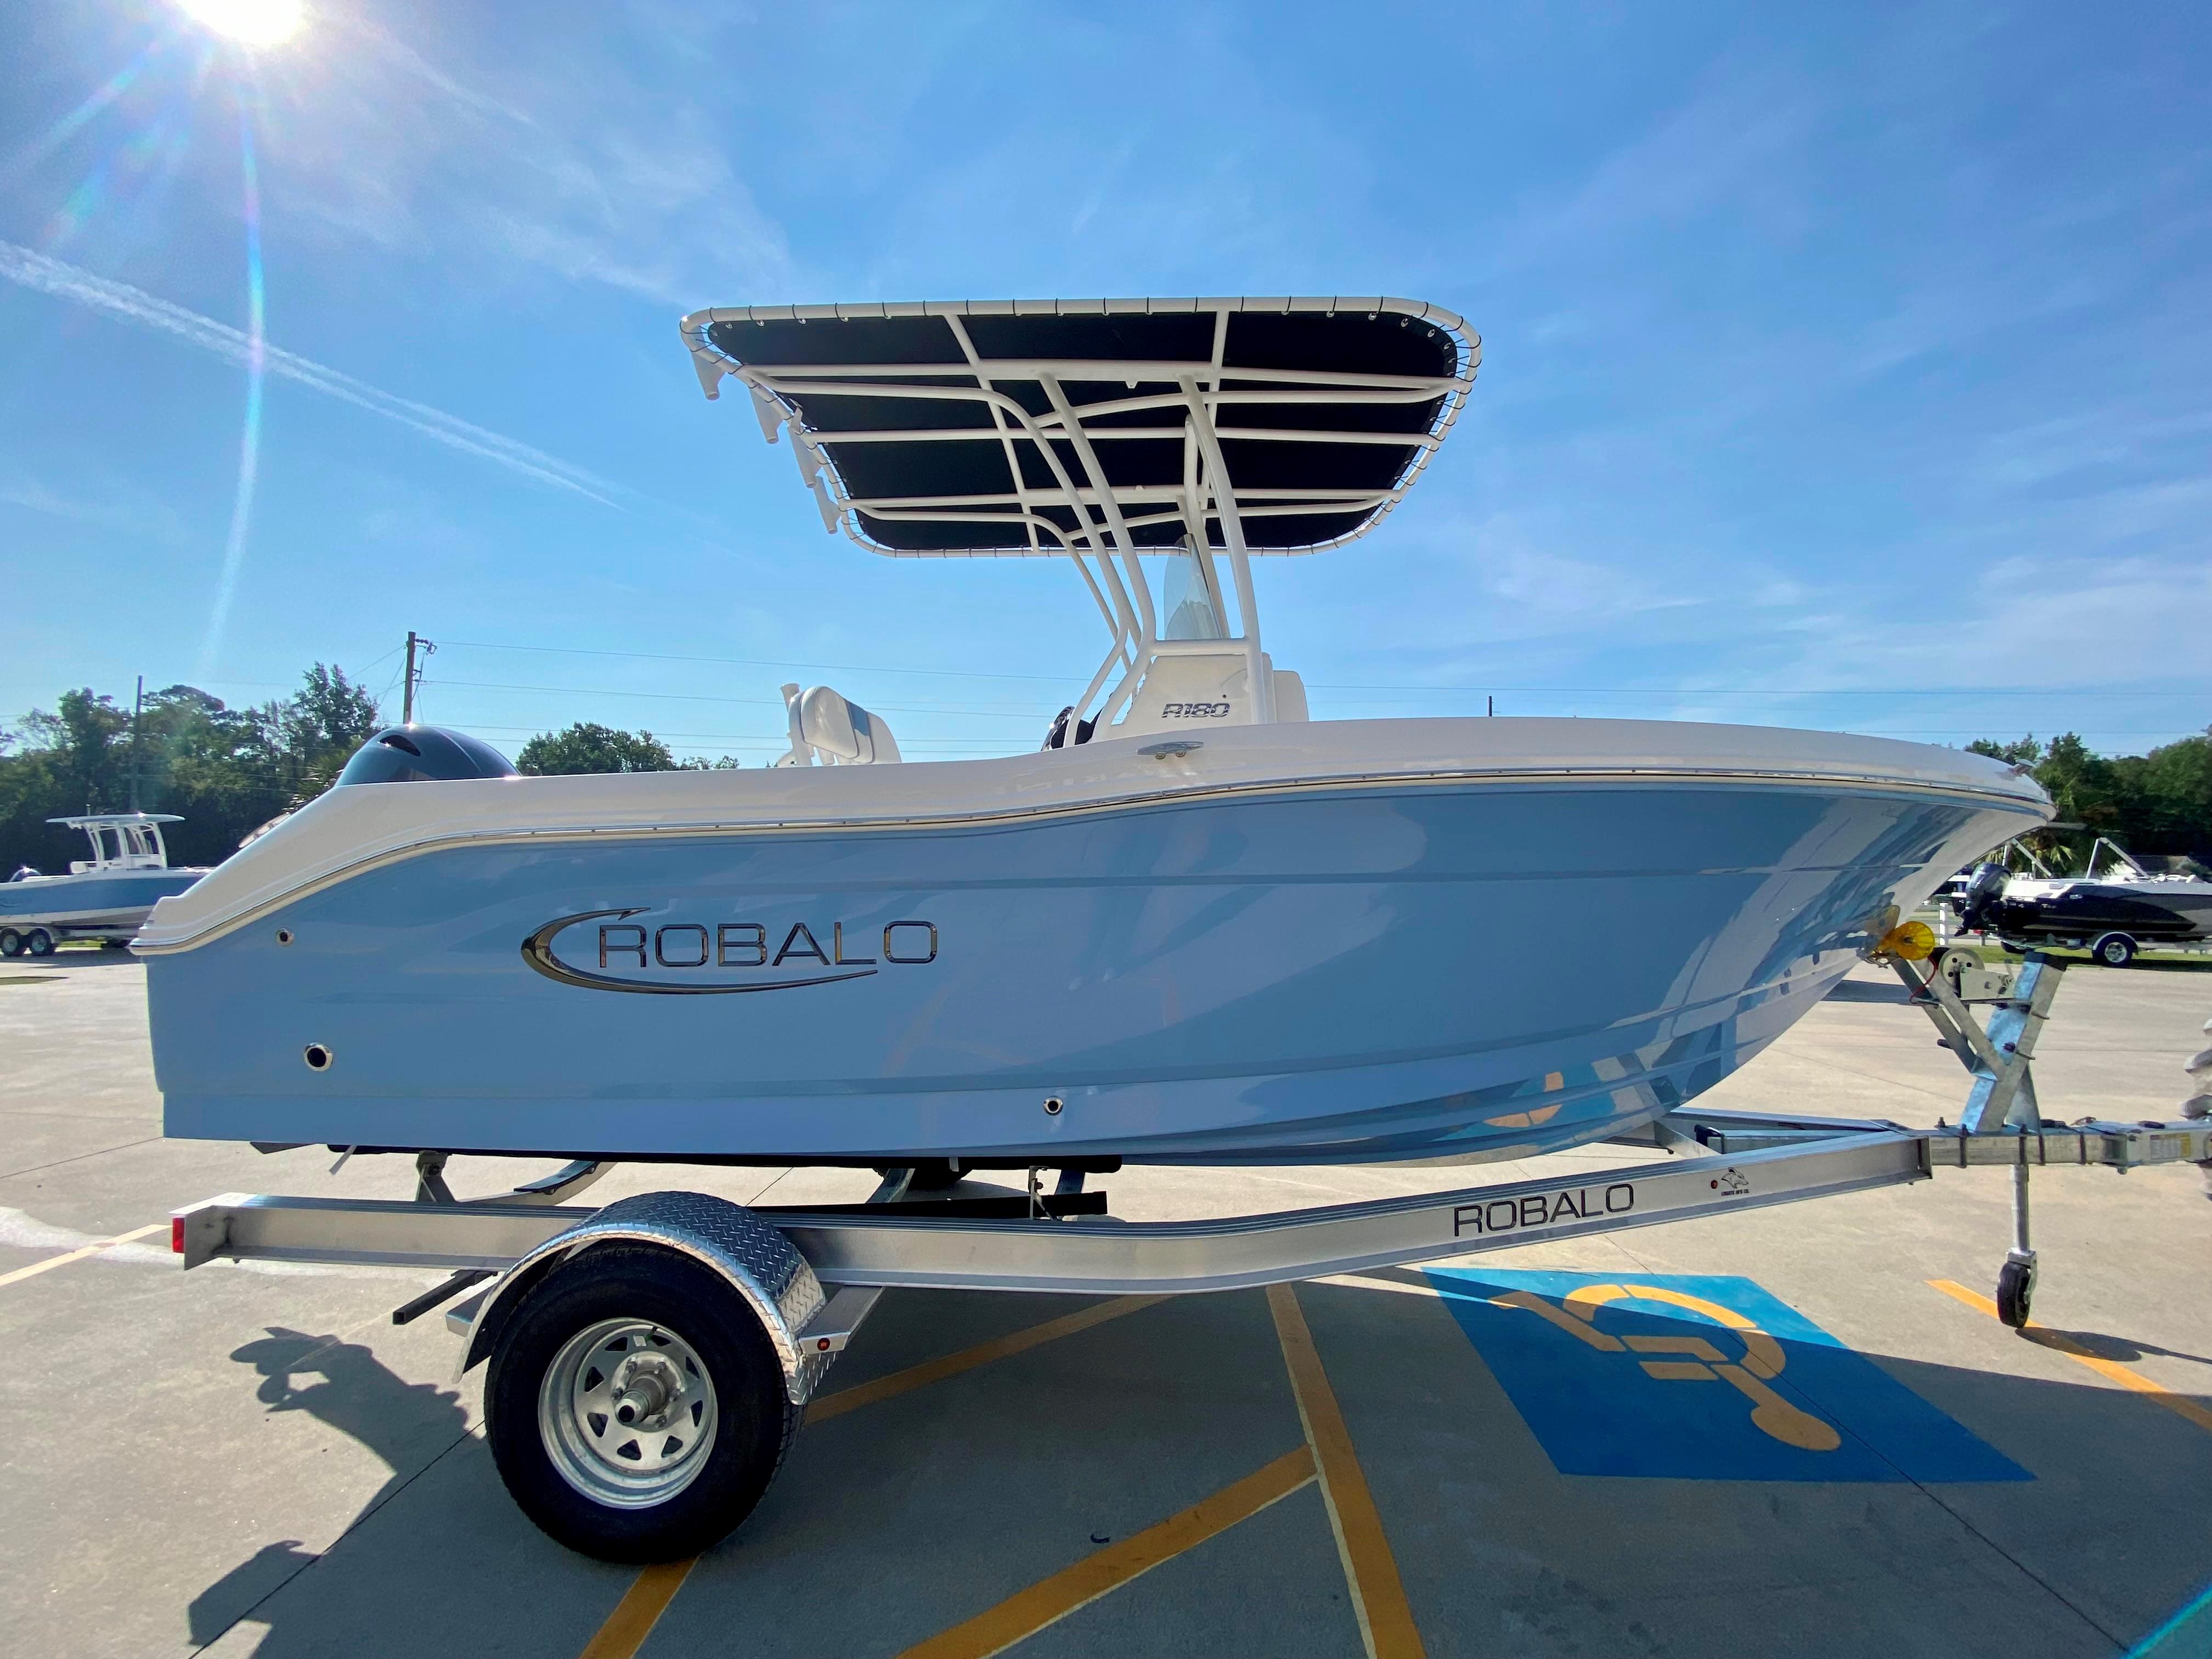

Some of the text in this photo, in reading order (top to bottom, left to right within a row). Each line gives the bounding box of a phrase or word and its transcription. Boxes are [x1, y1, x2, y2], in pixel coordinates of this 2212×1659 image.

[1161, 703, 1230, 718] R180
[599, 921, 938, 968] ROBALO
[1454, 1183, 1634, 1237] ROBALO
